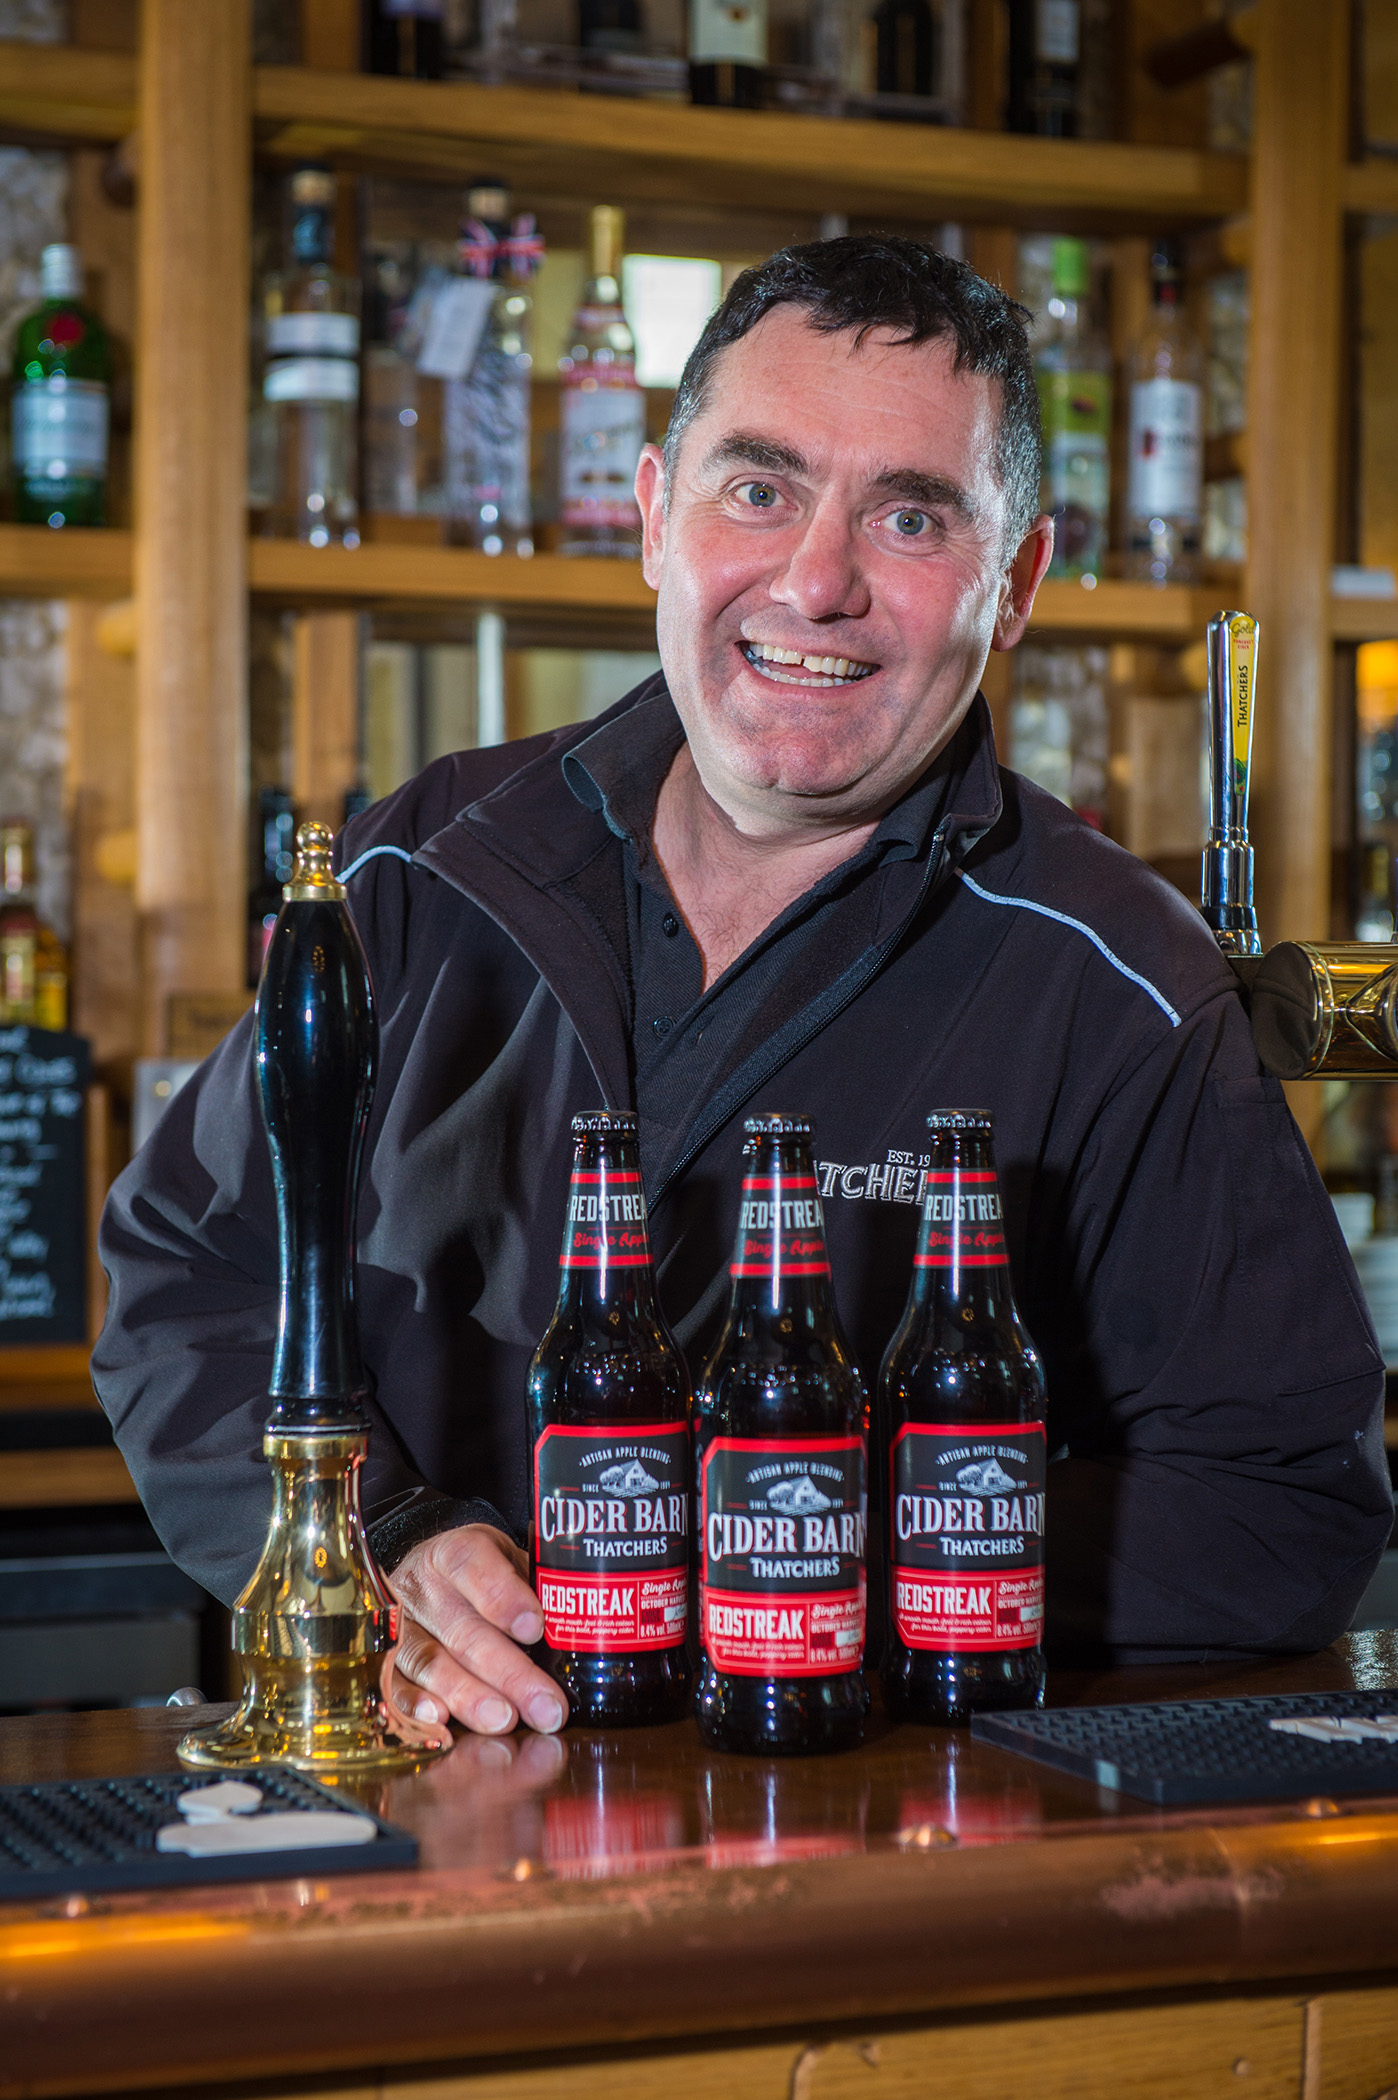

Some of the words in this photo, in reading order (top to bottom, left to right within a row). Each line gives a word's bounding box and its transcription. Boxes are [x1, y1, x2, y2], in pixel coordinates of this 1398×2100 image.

[1237, 665, 1248, 727] THATCHERS
[888, 1149, 915, 1165] EST.
[918, 1154, 931, 1167] 19
[573, 1232, 617, 1250] Singe
[744, 1240, 787, 1258] Singe
[581, 1448, 612, 1467] ARTISAN
[615, 1446, 638, 1458] APPLE
[640, 1447, 671, 1464] BLENDING
[938, 1446, 971, 1466] ARTISAN
[972, 1444, 996, 1457] APPLE
[997, 1445, 1028, 1464] BLENDING
[748, 1463, 782, 1484] ARTISAN
[784, 1461, 808, 1474] APPLE
[810, 1461, 843, 1482] BLENDING
[582, 1483, 599, 1493] SINCE
[541, 1496, 628, 1542] CIDER
[897, 1494, 985, 1541] CIDER
[583, 1536, 668, 1557] THATCHERS
[708, 1512, 797, 1562] CIDER
[802, 1511, 864, 1557] BARN
[939, 1535, 1024, 1556] THATCHERS
[749, 1556, 840, 1578] THATCHERS
[642, 1582, 671, 1596] Single
[896, 1582, 992, 1615] REDSTREAK
[998, 1581, 1028, 1595] Single
[541, 1583, 635, 1616] REDSTREAK
[641, 1598, 668, 1610] OCTOBER
[811, 1603, 843, 1619] Single
[641, 1623, 656, 1638] 8.4%
[709, 1604, 804, 1640] REDSTREAK
